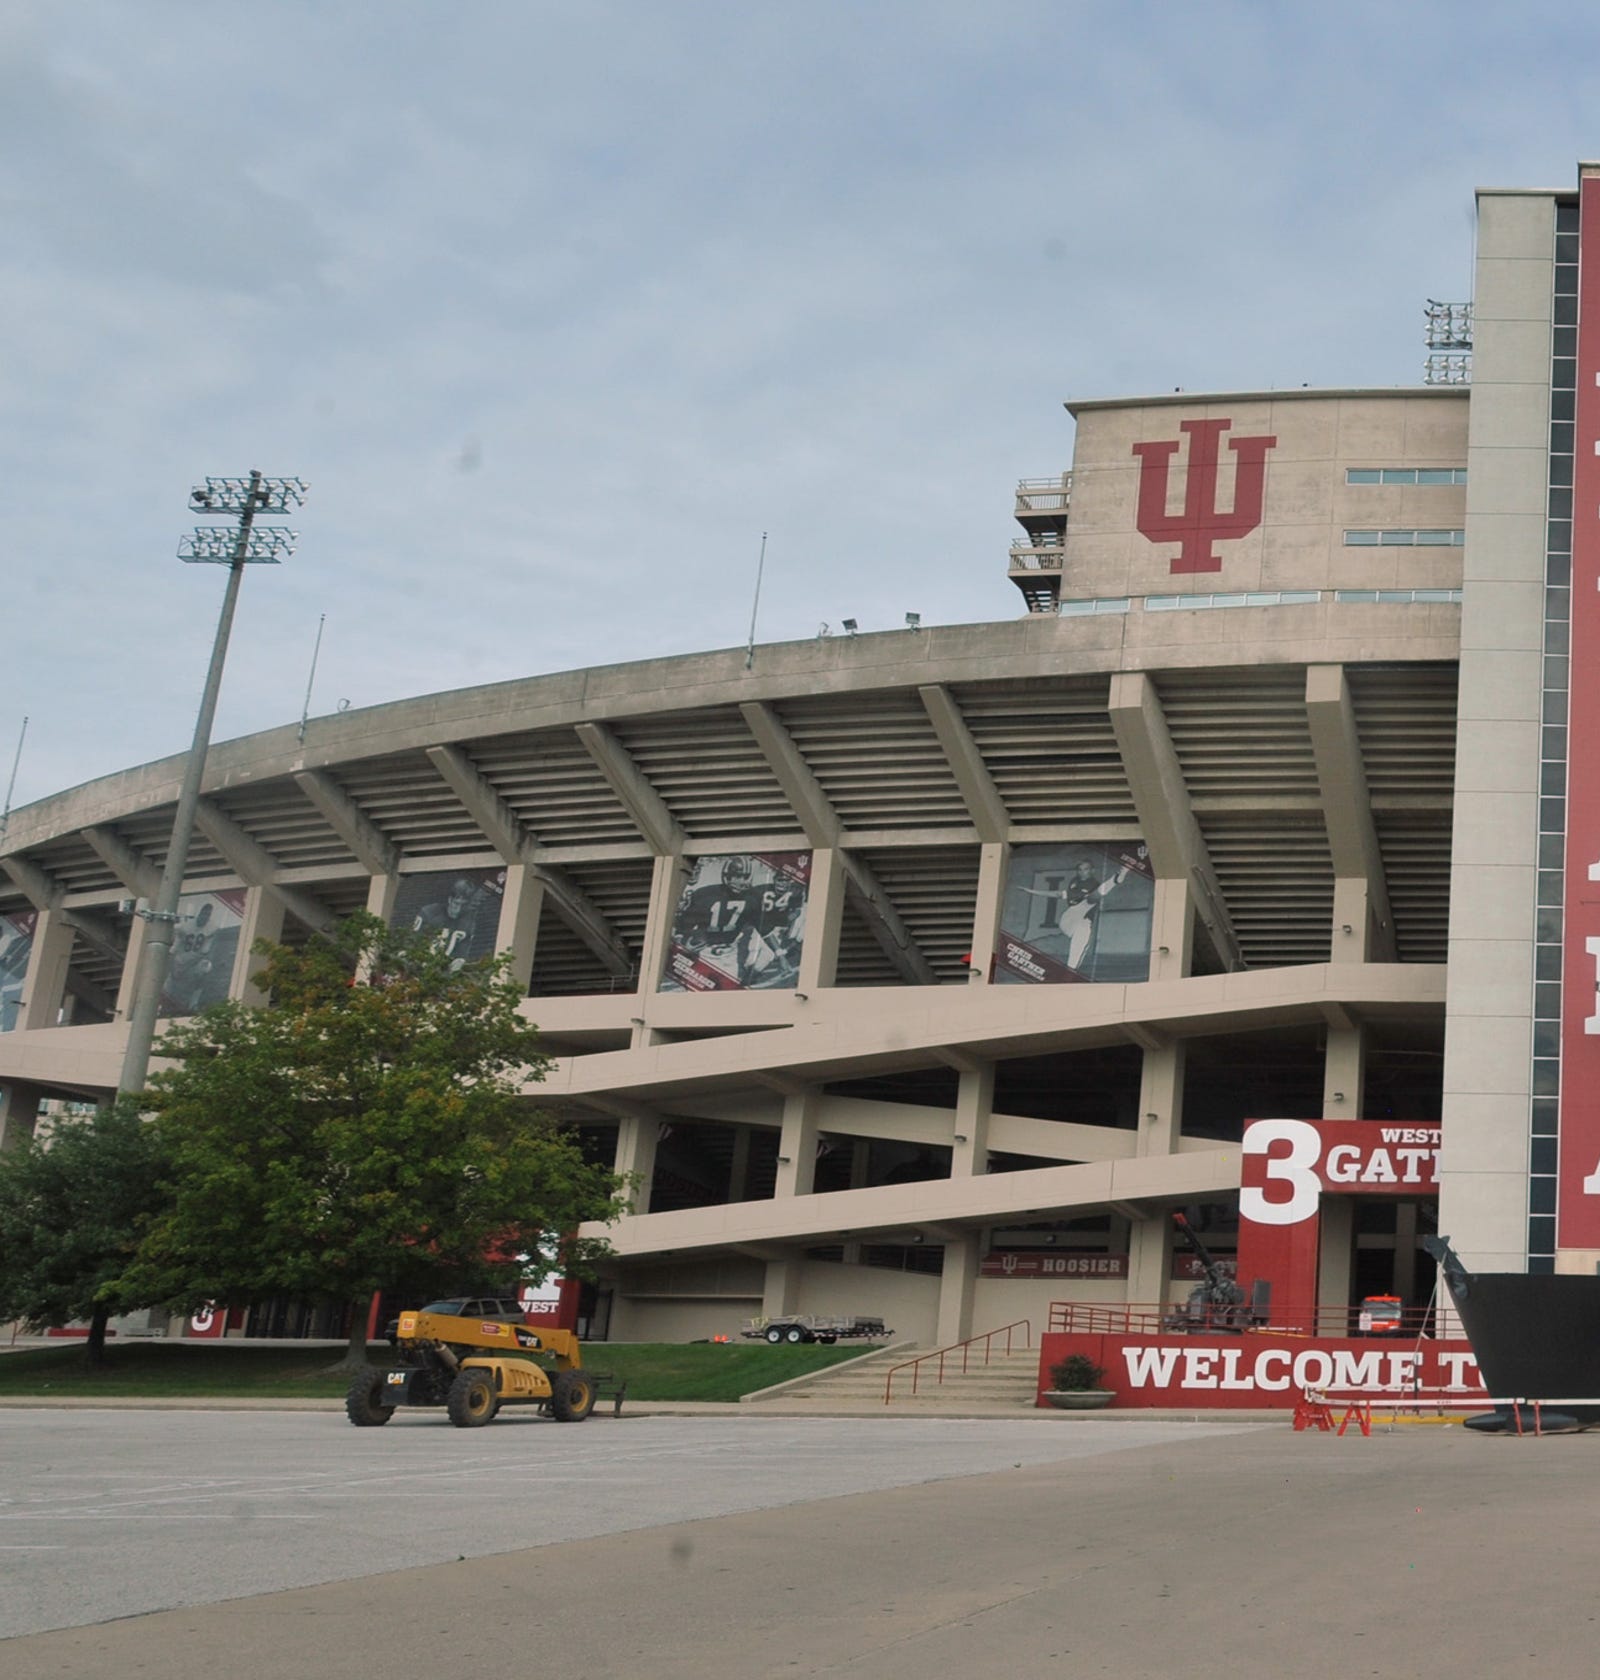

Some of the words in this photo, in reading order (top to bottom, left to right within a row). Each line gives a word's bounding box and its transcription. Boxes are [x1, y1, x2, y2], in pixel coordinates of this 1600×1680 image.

[706, 901, 747, 932] 17
[1380, 1128, 1442, 1144] WEST
[1239, 1119, 1322, 1225] 3
[1042, 1258, 1121, 1274] HOOSIER
[518, 1301, 559, 1314] WEST
[1122, 1347, 1423, 1392] WELCOME
[1439, 1353, 1488, 1393] T
[387, 1372, 405, 1385] CAT
